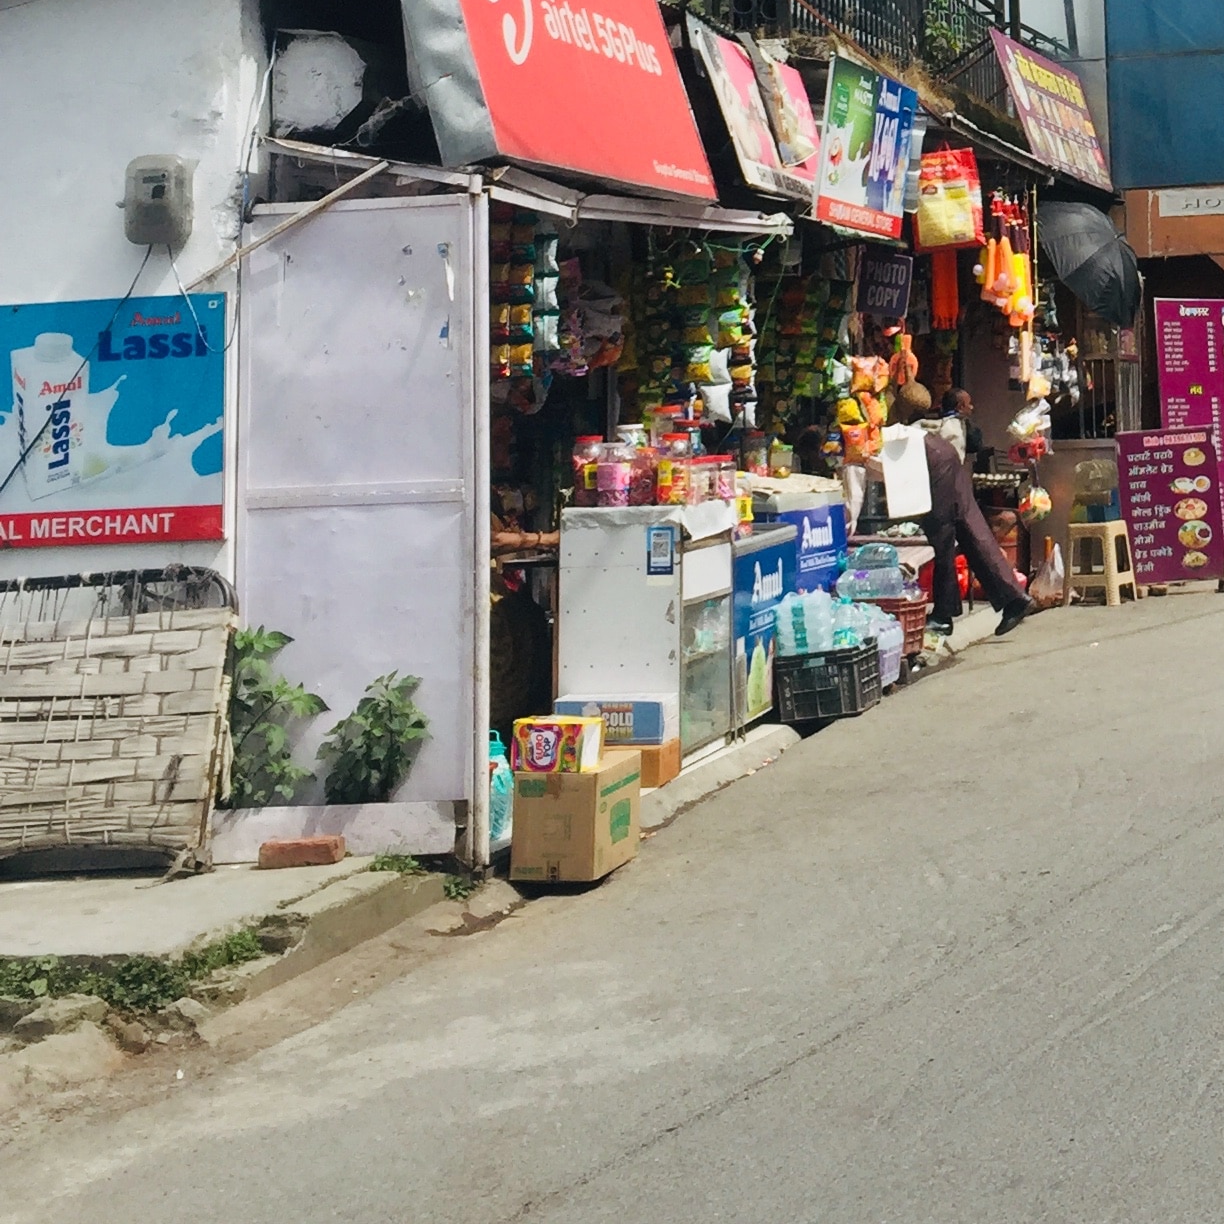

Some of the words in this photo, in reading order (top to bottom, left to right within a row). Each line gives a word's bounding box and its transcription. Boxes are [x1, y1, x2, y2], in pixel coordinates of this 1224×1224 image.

[866, 261, 907, 286] PHOTO
[866, 285, 901, 309] COPY
[97, 325, 208, 363] Lassi
[38, 376, 83, 398] Amul
[46, 399, 72, 470] Lassi
[29, 512, 175, 539] MERCHANT
[801, 515, 834, 554] Amul
[751, 556, 783, 604] Amul
[602, 711, 634, 727] COLD
